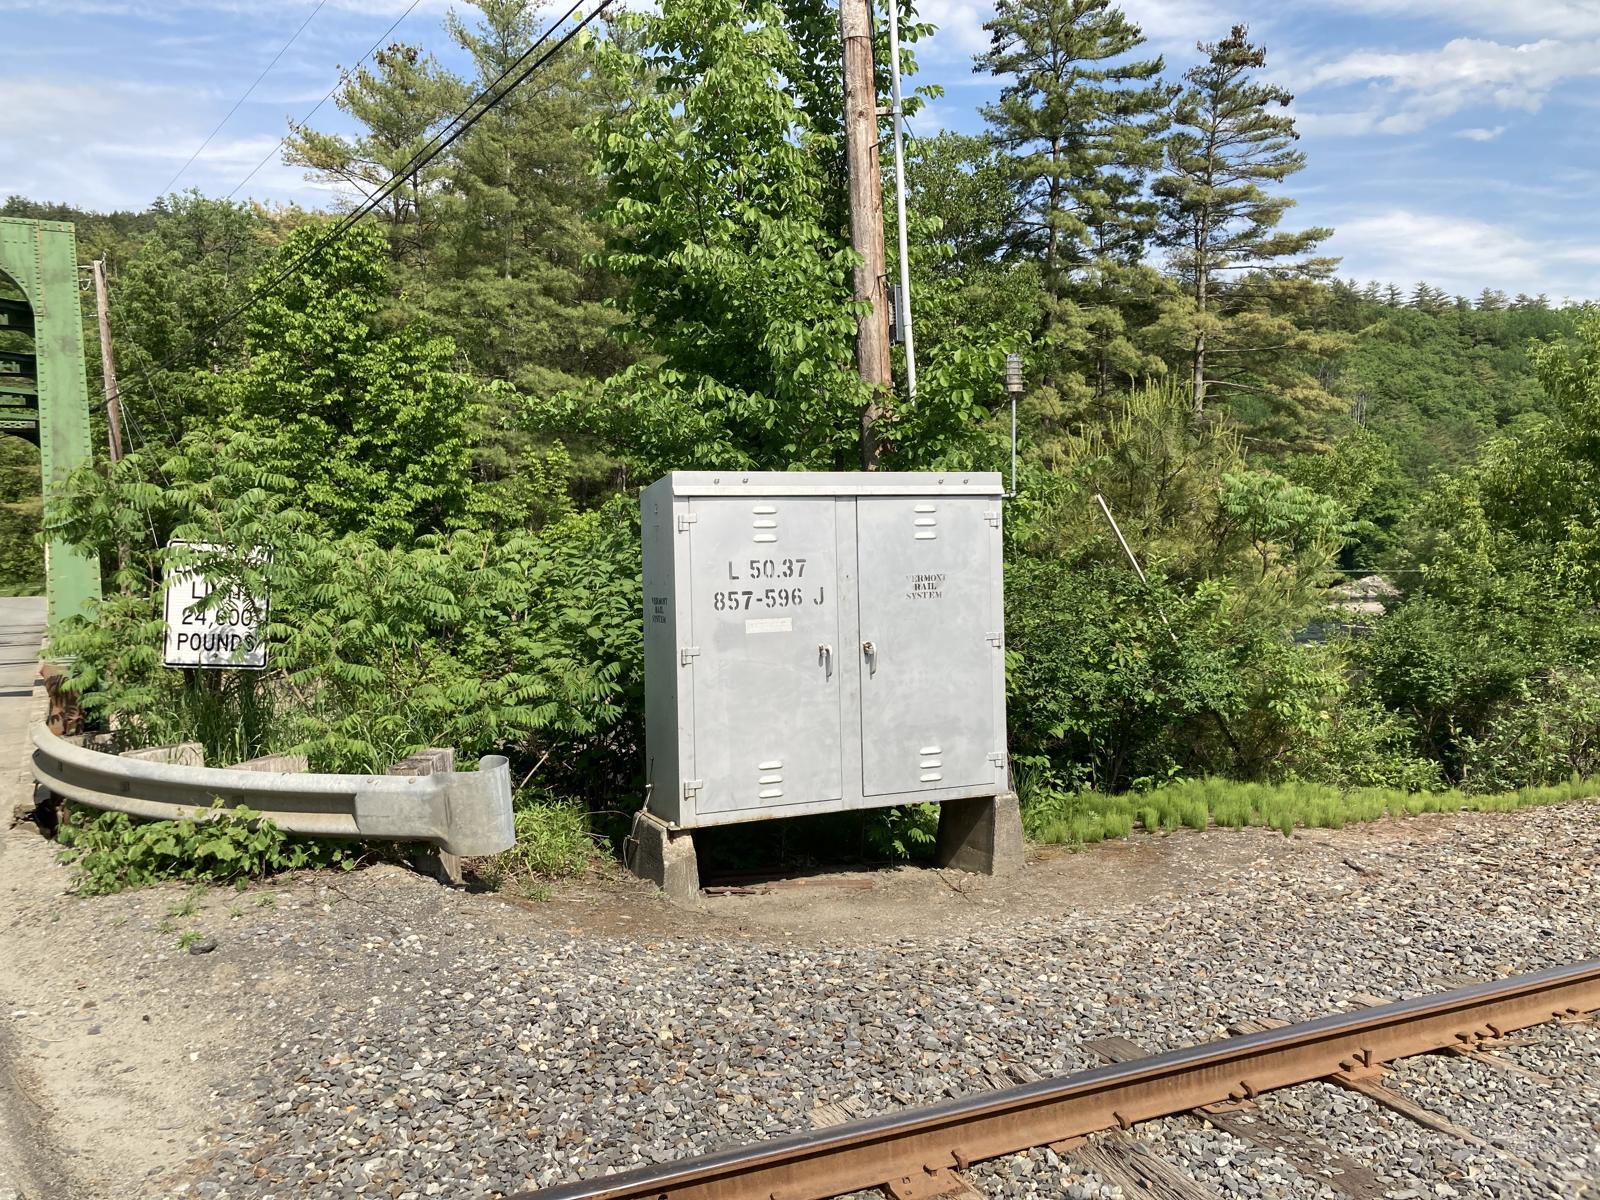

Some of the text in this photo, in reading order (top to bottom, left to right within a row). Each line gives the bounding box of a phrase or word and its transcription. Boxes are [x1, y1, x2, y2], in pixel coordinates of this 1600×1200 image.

[728, 558, 807, 580] L 50.37
[905, 591, 943, 600] SYSTEM
[914, 582, 937, 591] RAIL
[714, 586, 825, 611] 857-596 J
[176, 632, 255, 653] POUNDS
